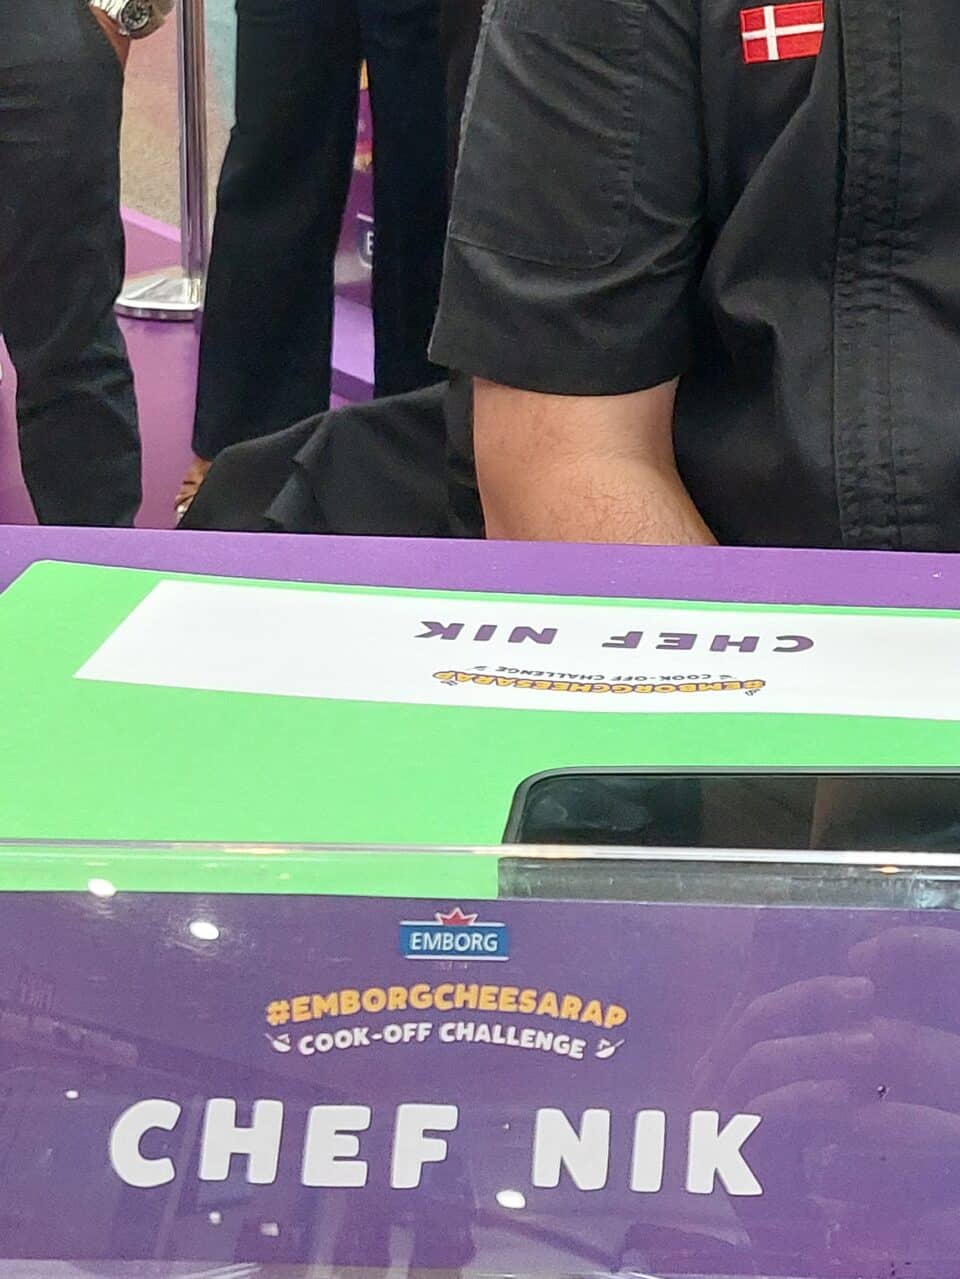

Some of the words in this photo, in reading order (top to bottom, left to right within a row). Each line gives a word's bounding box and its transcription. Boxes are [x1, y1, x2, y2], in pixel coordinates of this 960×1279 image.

[414, 621, 559, 645] NIK
[602, 630, 815, 653] CHEF
[409, 932, 499, 952] EMBORG
[265, 983, 629, 1029] #EMBORGCHEESARAP
[299, 1022, 433, 1056] COOK-OFF
[439, 1021, 588, 1060] CHALLENGE
[108, 1098, 459, 1189] CHEF
[531, 1106, 764, 1197] NIK
